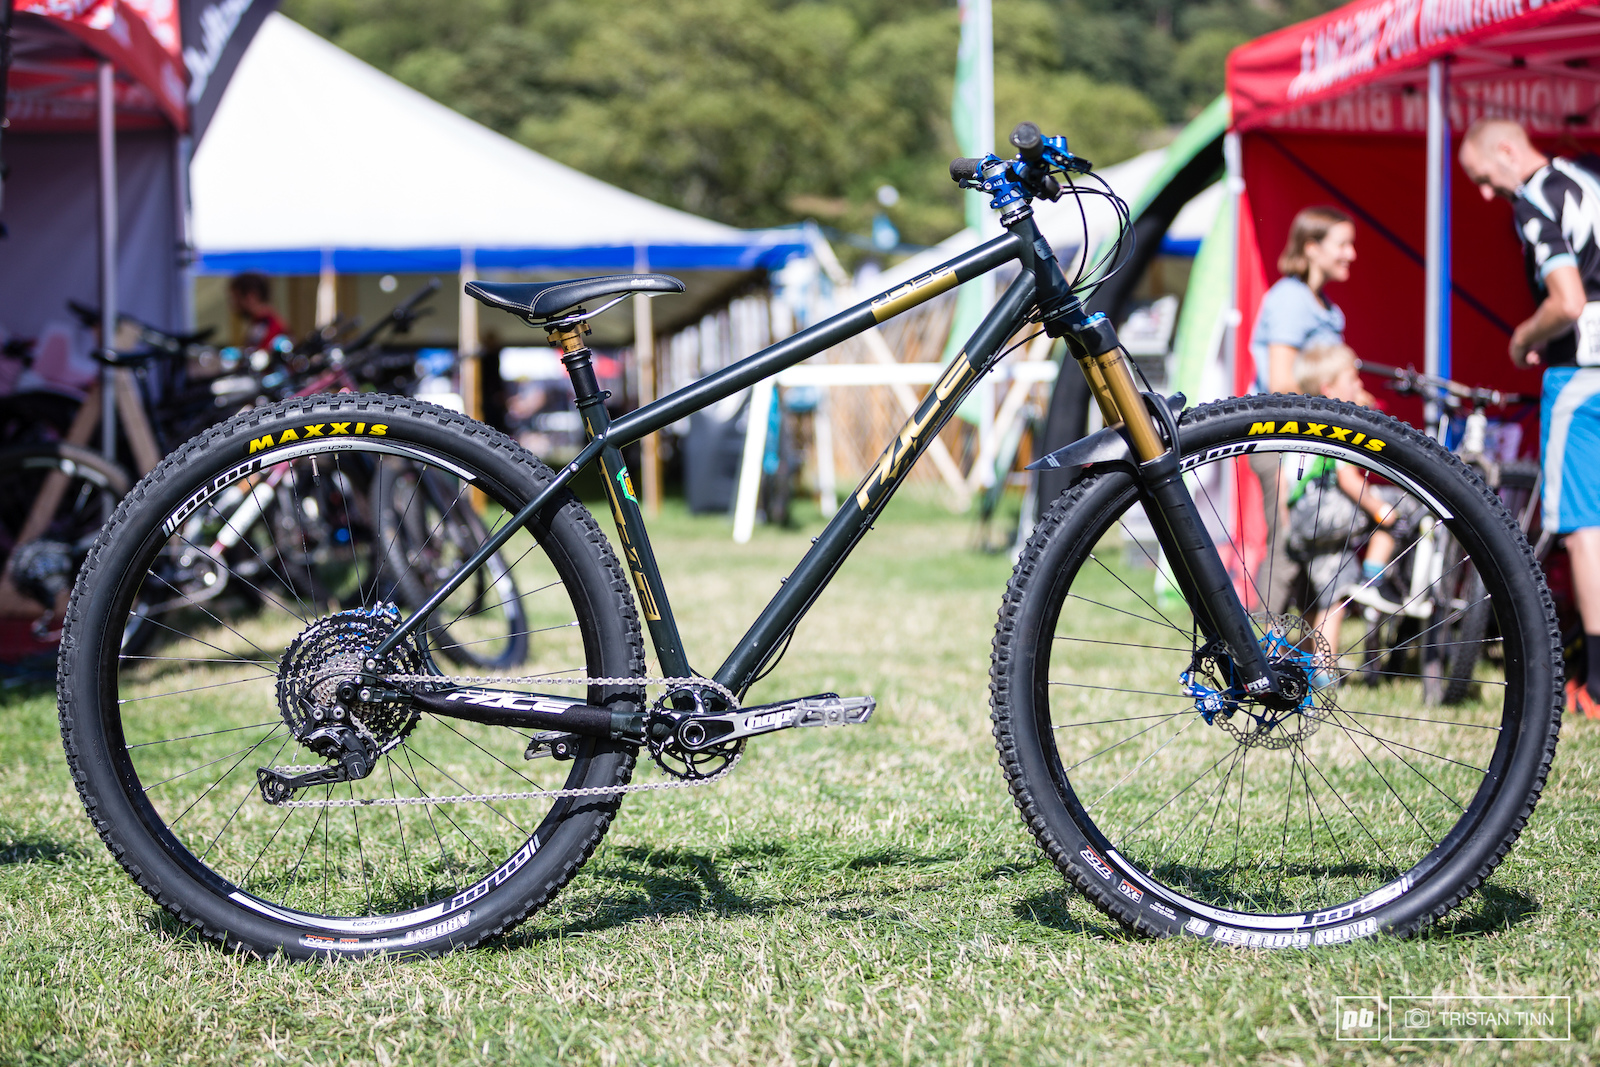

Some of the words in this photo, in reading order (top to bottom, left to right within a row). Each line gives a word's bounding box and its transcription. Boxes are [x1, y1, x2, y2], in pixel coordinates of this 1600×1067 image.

[249, 422, 388, 454] MAXXIS
[1248, 421, 1387, 452] MAXXIS
[1180, 443, 1258, 472] hop
[1119, 883, 1141, 902] EXO
[402, 910, 471, 946] ARDENT
